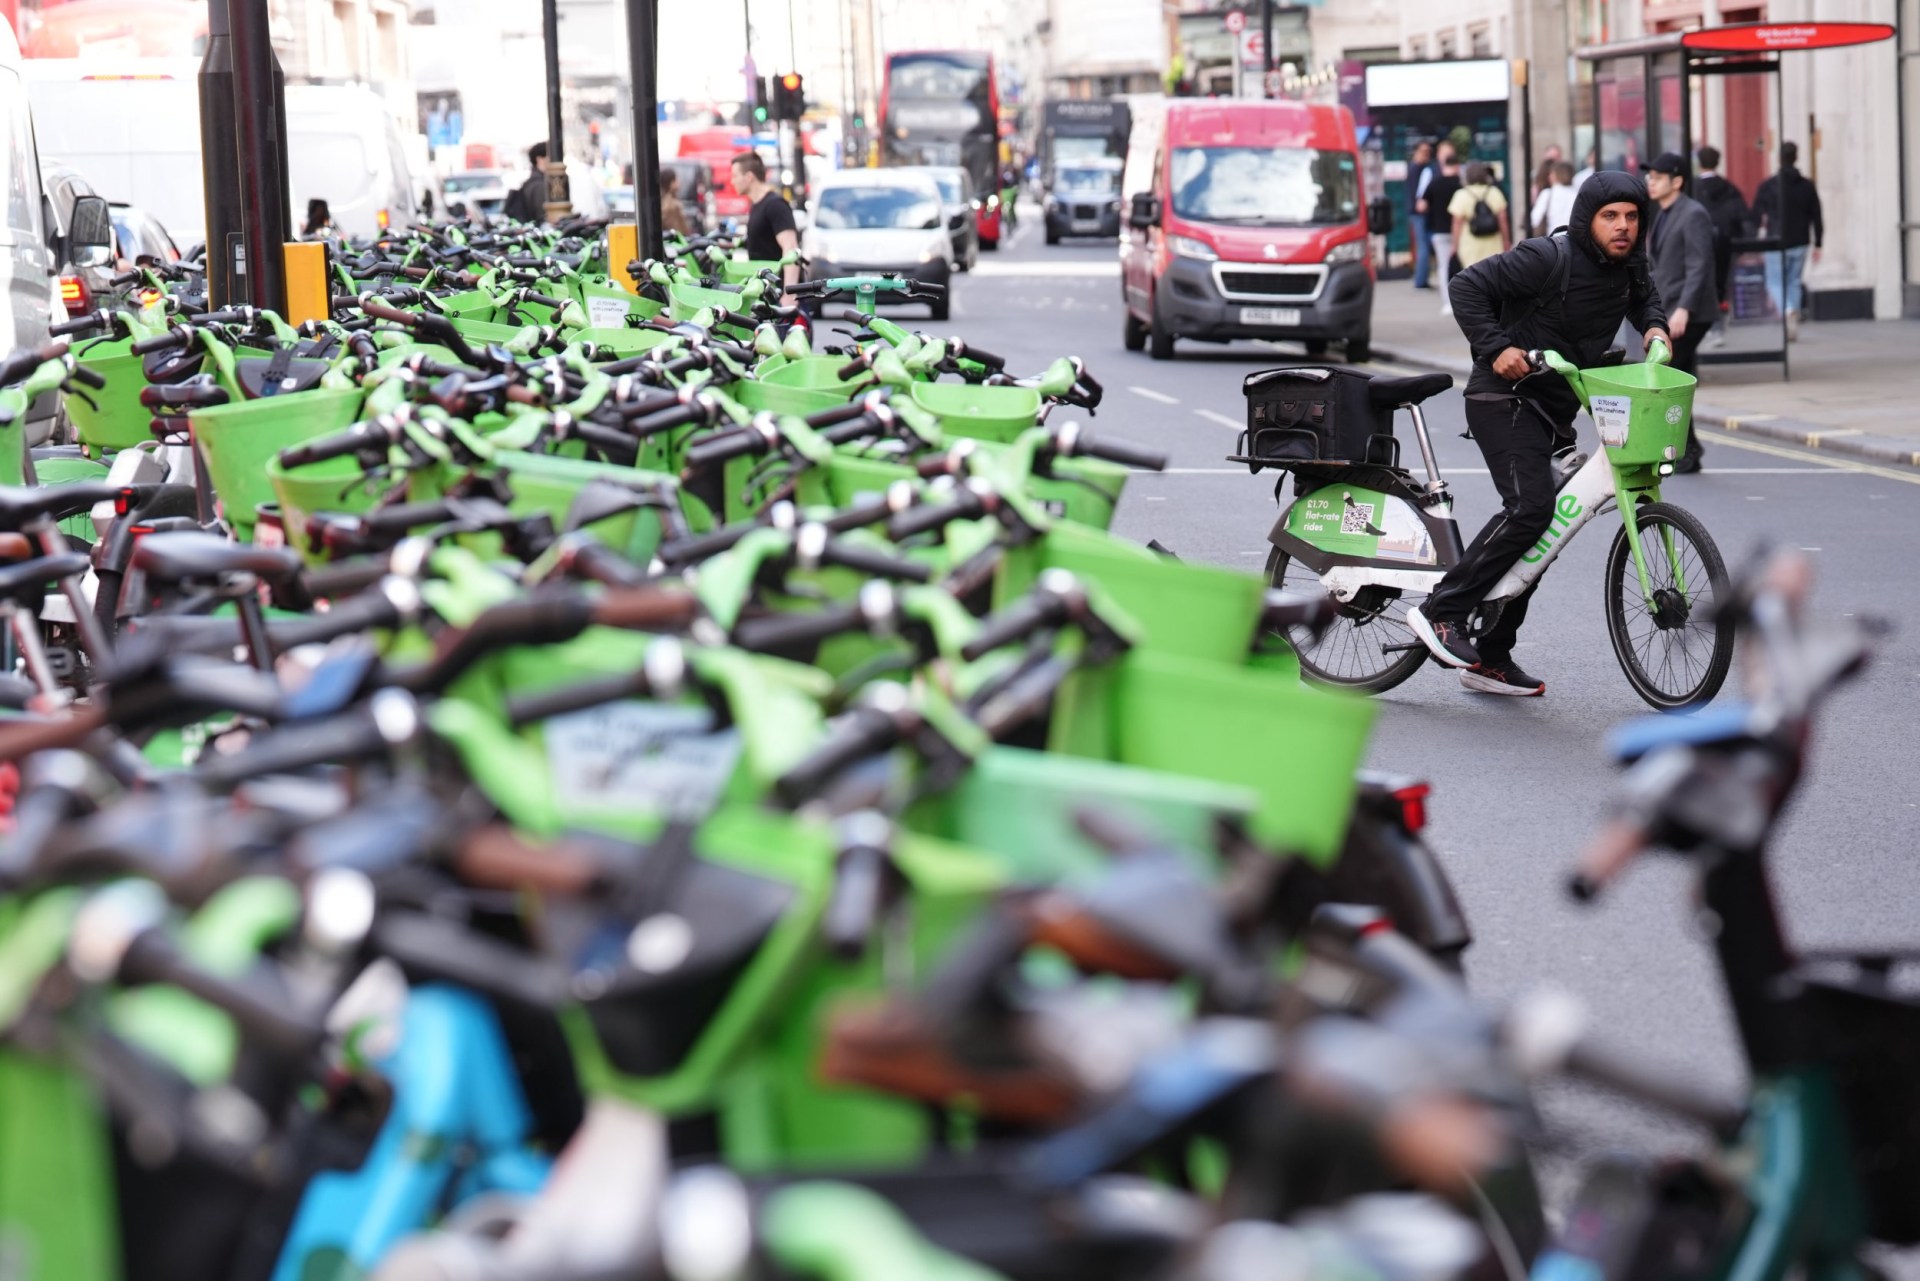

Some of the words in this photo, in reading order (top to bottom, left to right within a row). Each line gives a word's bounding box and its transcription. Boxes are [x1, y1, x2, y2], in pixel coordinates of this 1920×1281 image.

[1307, 500, 1329, 509] £1.70
[1305, 510, 1340, 521] flat-rate
[1303, 522, 1323, 531] rides
